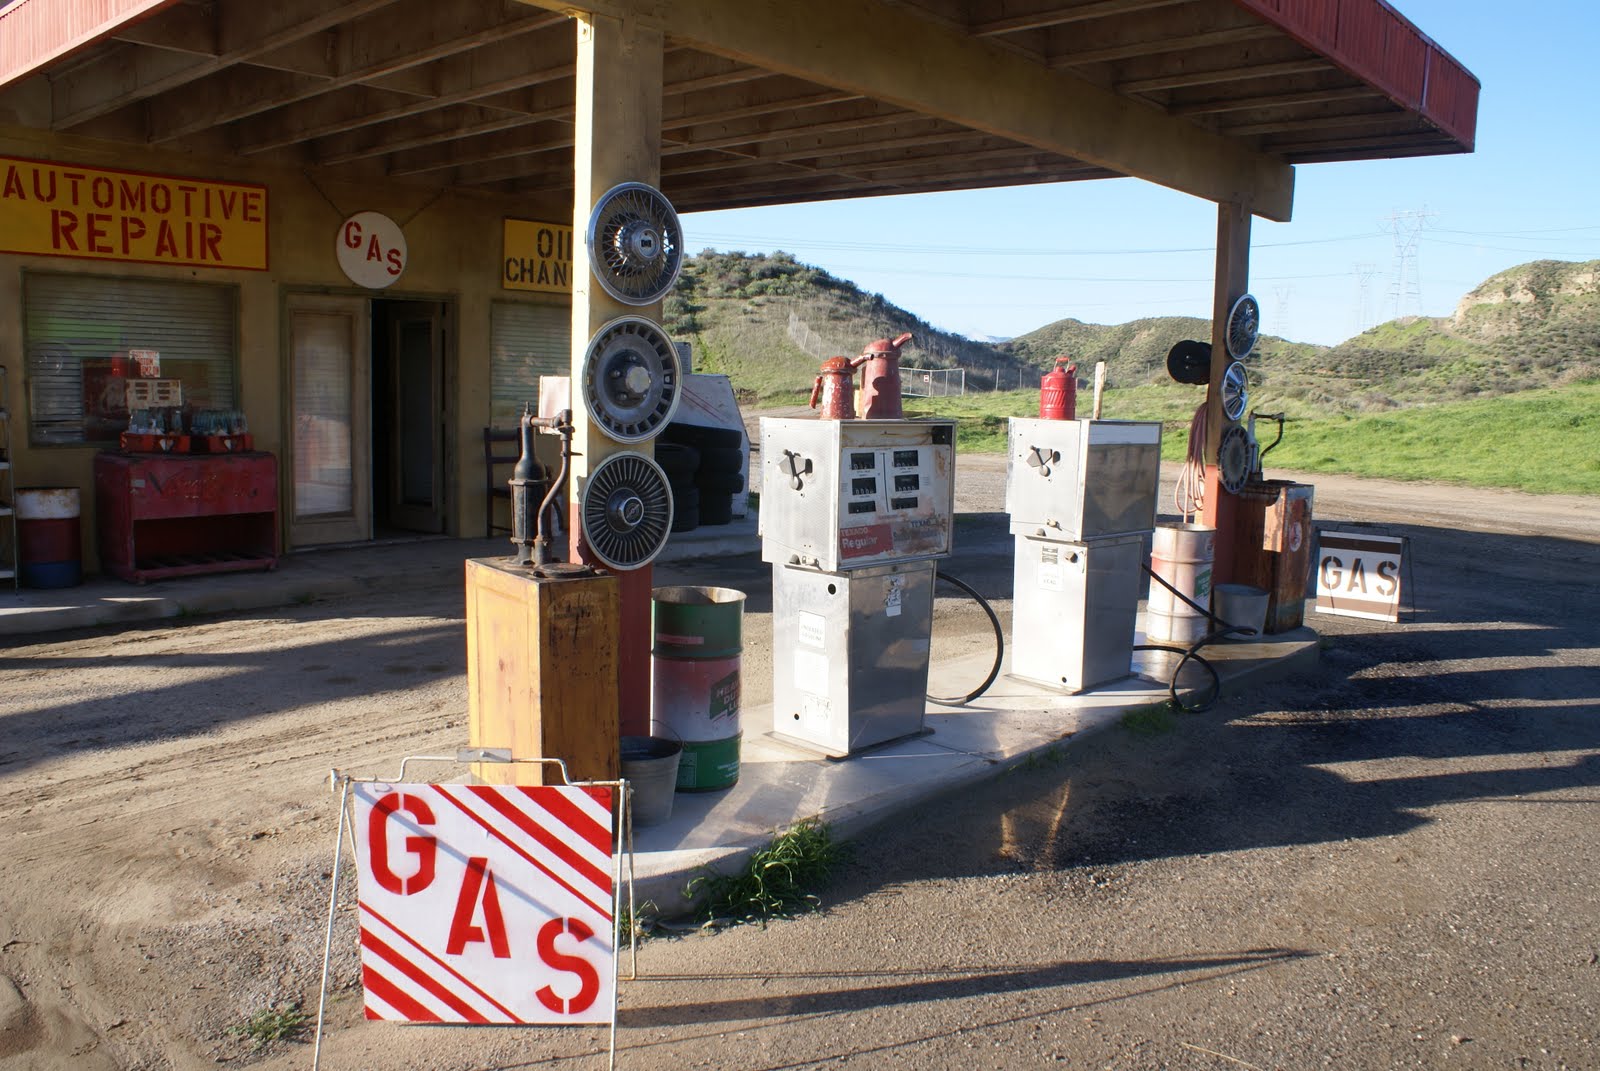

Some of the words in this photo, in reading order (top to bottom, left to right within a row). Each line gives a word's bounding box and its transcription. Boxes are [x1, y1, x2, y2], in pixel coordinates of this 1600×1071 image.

[3, 165, 261, 222] AUTOMOTIVE
[51, 209, 223, 261] REPAIR
[345, 221, 402, 275] GAS
[841, 536, 878, 549] Regular
[1320, 556, 1398, 596] GAS
[368, 792, 600, 1014] GAS
